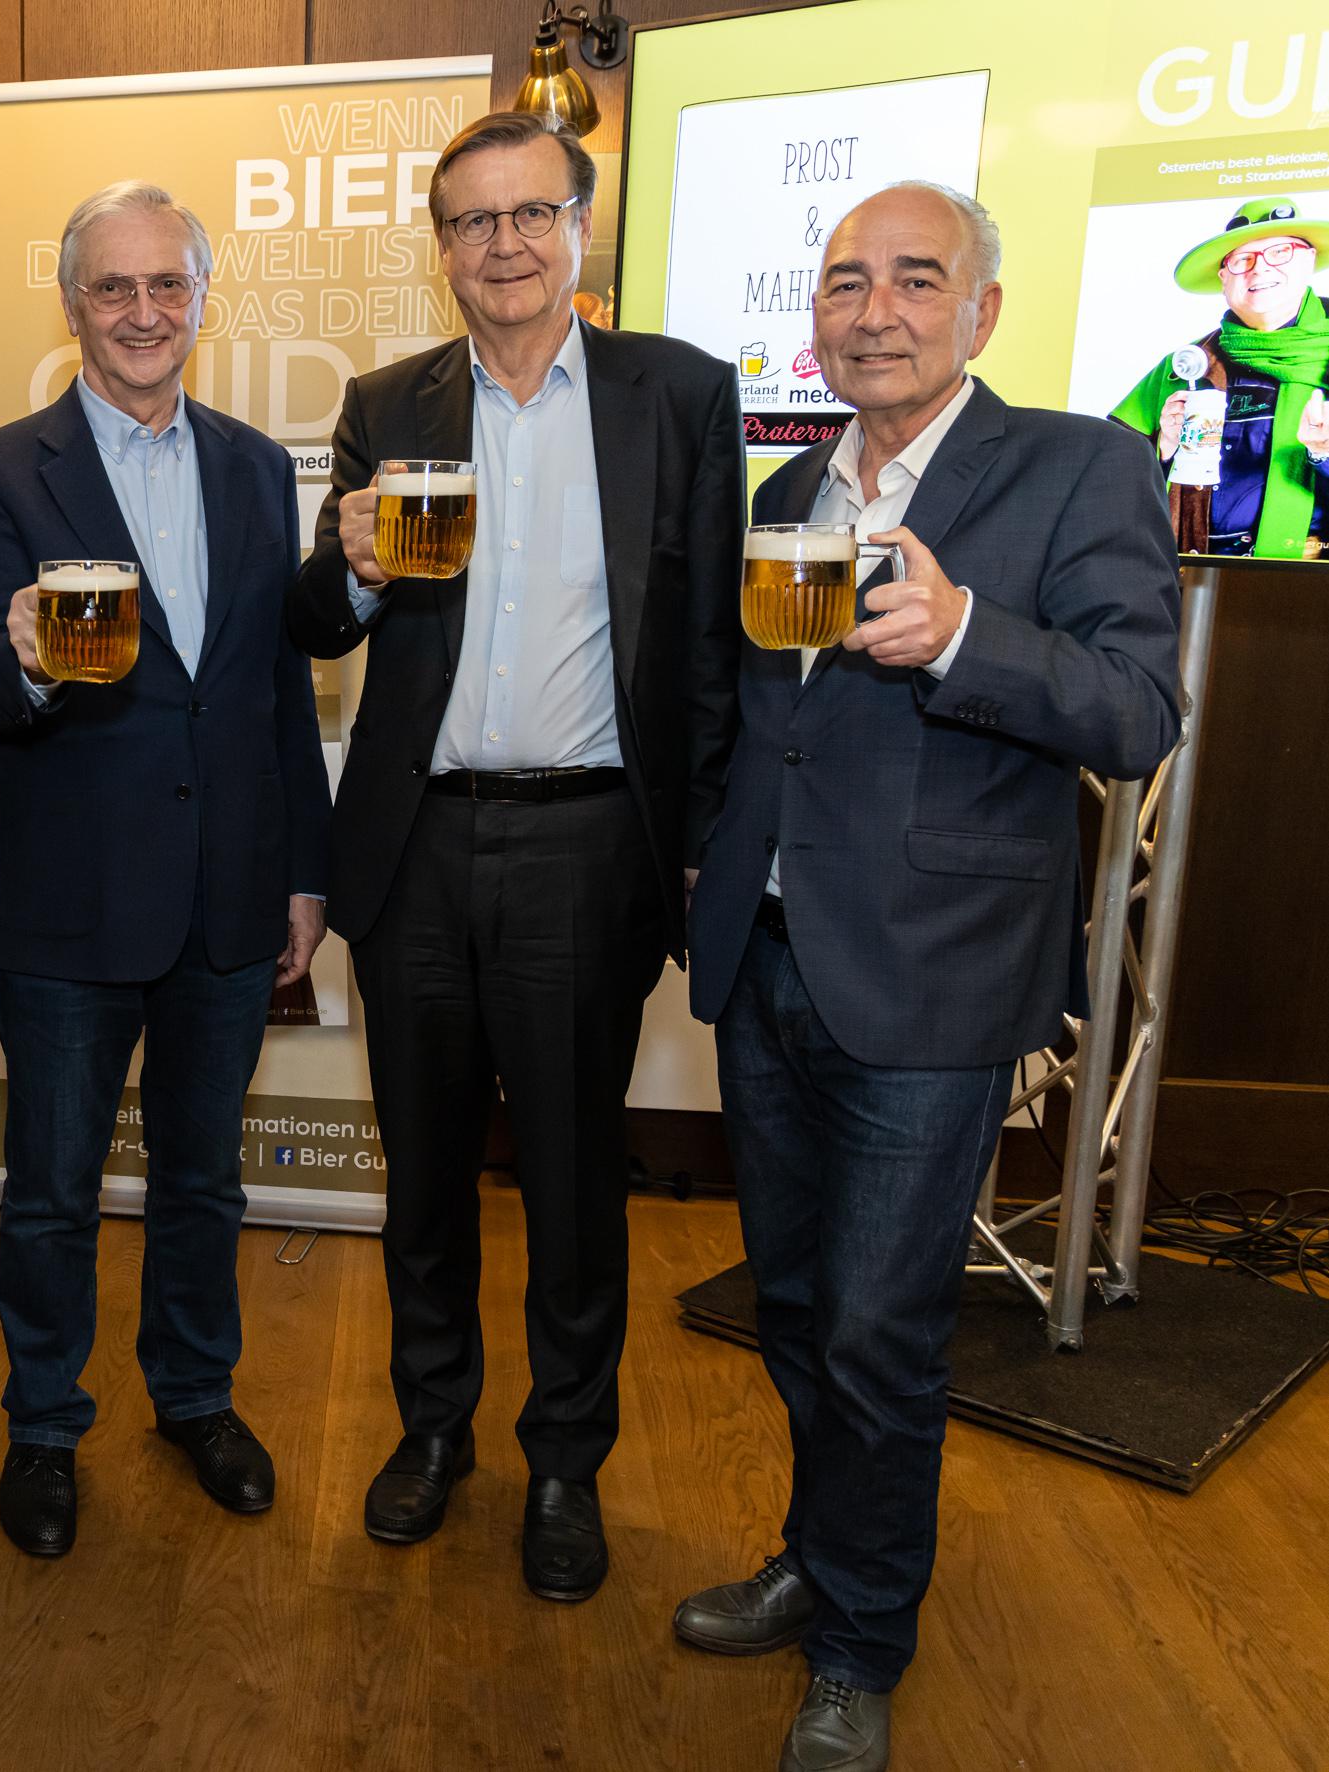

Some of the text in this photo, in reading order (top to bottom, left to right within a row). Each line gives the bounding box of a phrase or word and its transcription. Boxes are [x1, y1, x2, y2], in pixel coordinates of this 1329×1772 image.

[278, 95, 463, 155] WENN
[782, 137, 859, 184] PROST
[1158, 160, 1226, 175] Österreichs
[1227, 156, 1263, 169] beste
[1217, 173, 1243, 185] Das
[805, 205, 823, 247] &
[209, 229, 357, 282] WELT
[320, 286, 457, 337] DEIN
[242, 1115, 355, 1139] mationen
[300, 1147, 347, 1168] Bier
